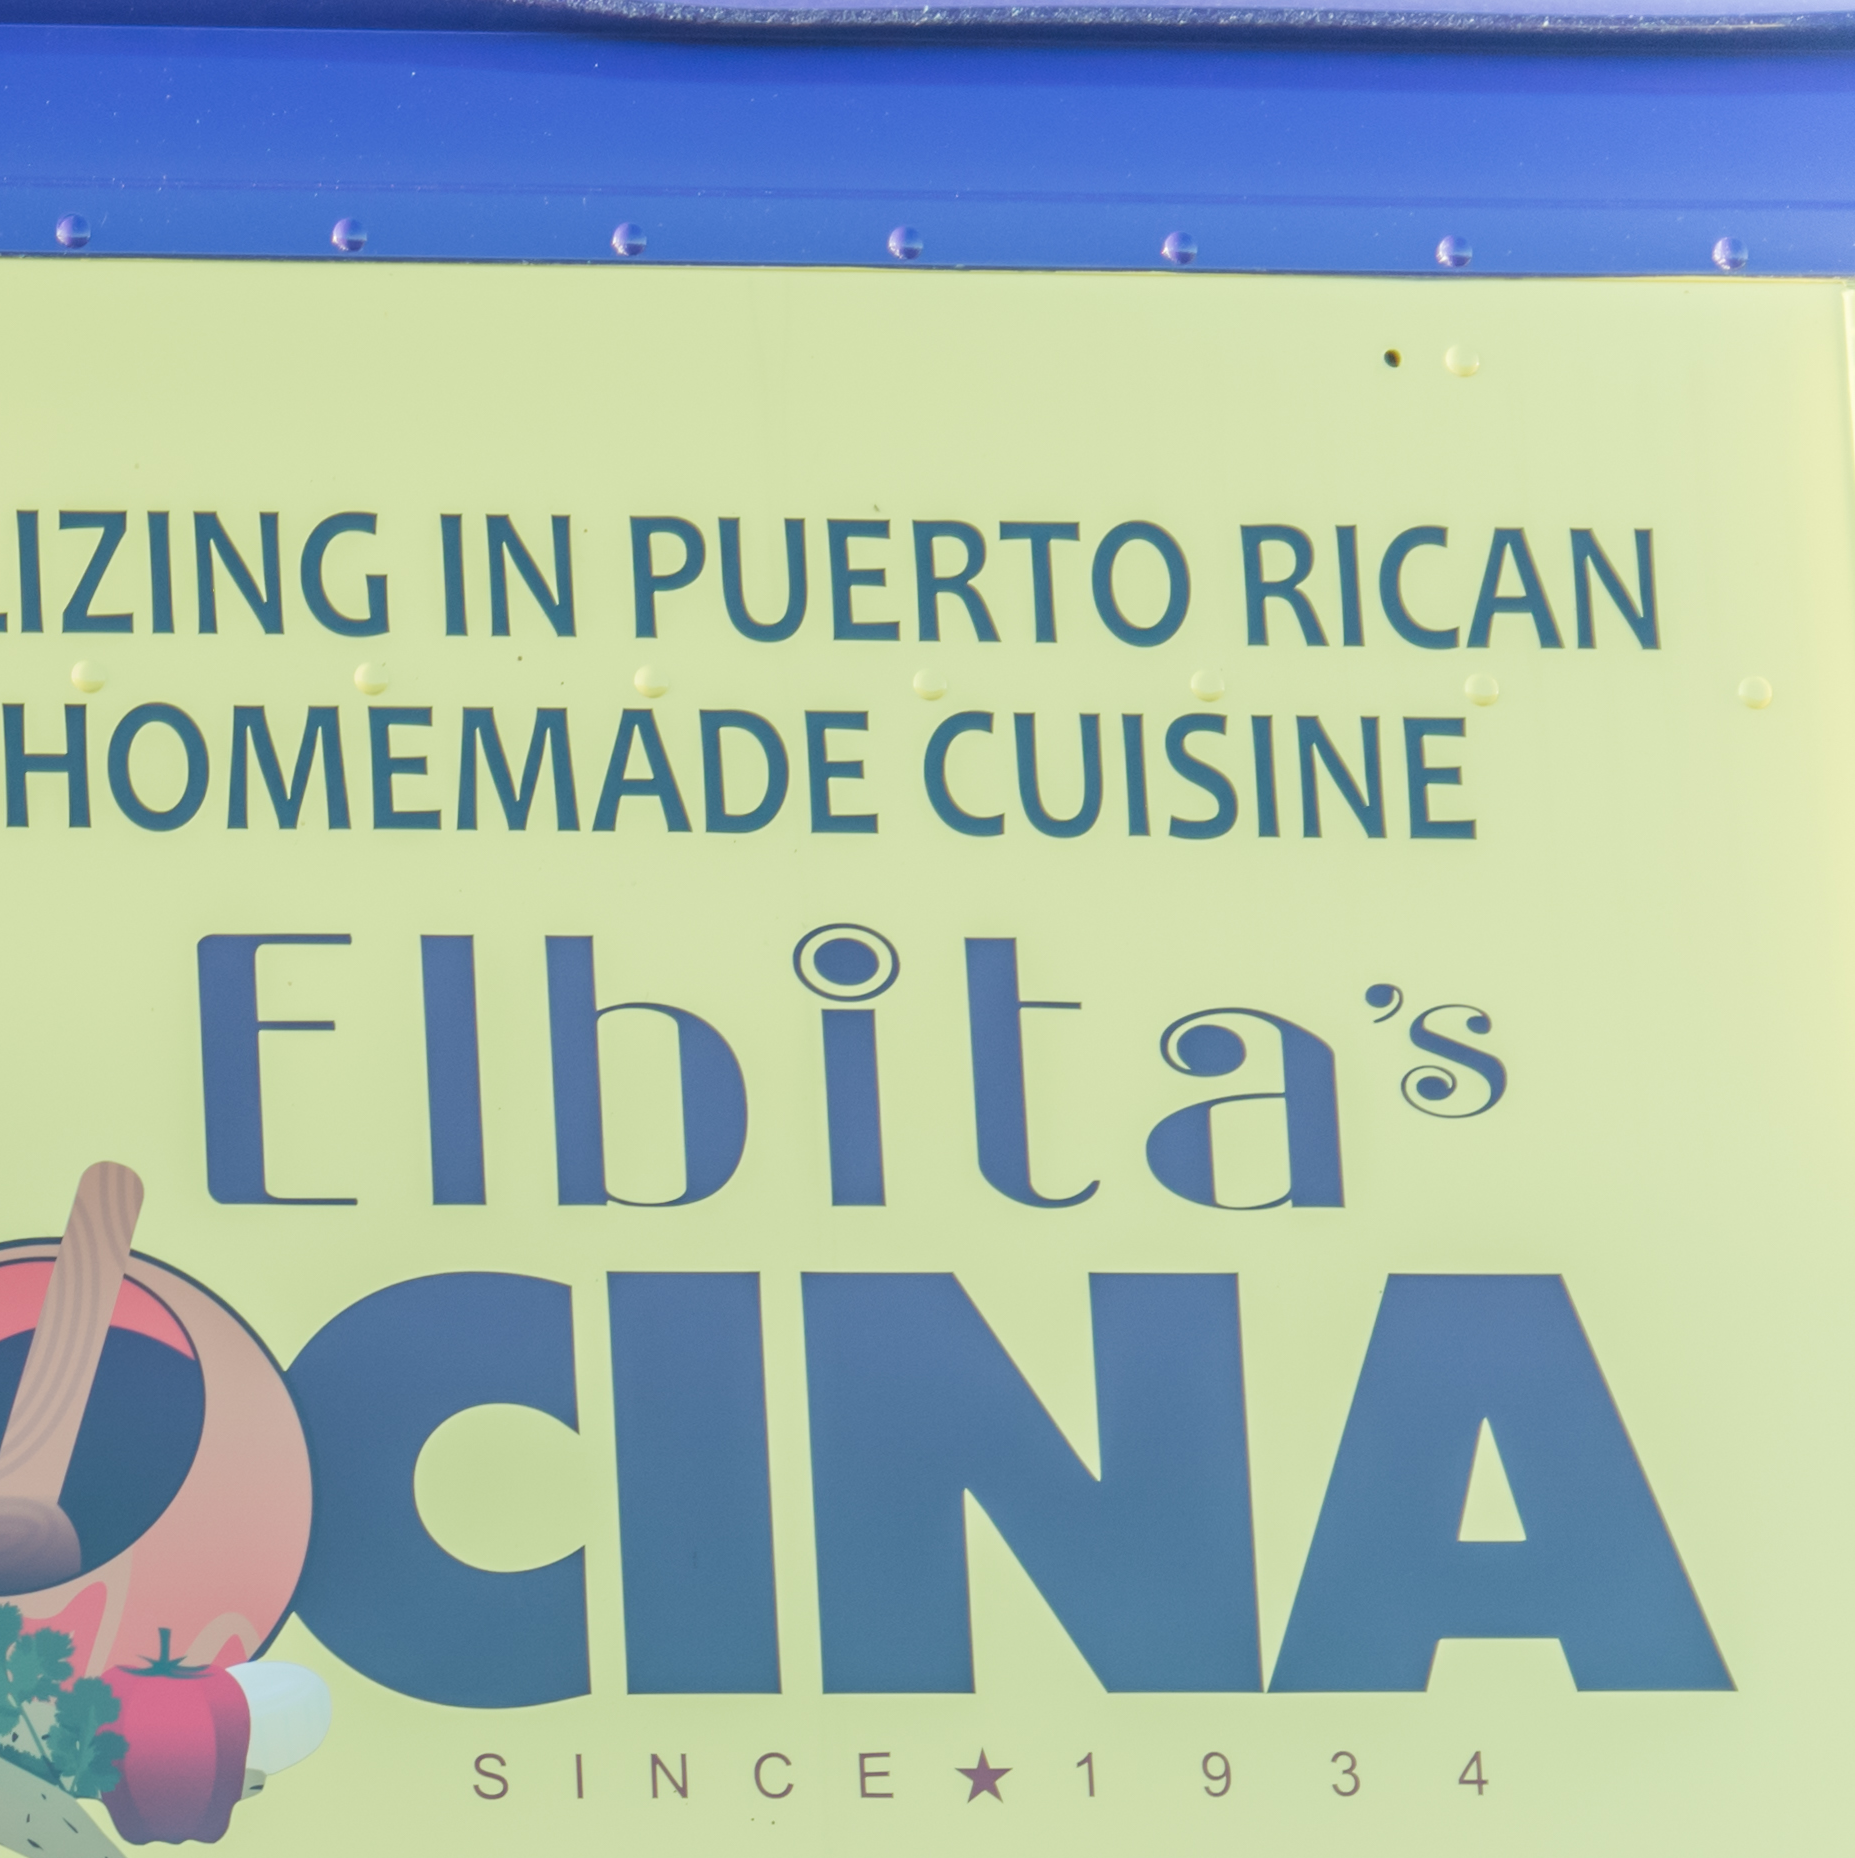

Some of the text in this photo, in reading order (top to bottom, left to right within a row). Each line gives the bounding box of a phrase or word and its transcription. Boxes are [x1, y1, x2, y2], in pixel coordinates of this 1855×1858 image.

[438, 512, 578, 639] IN
[628, 514, 1192, 649] PUERTO
[1238, 522, 1662, 652] RICAN
[0, 700, 880, 836] HOMEMADE
[922, 709, 1478, 842] CUISINE
[195, 921, 1509, 1212] Elbita's
[472, 1749, 1489, 1801] SINCE 1934
